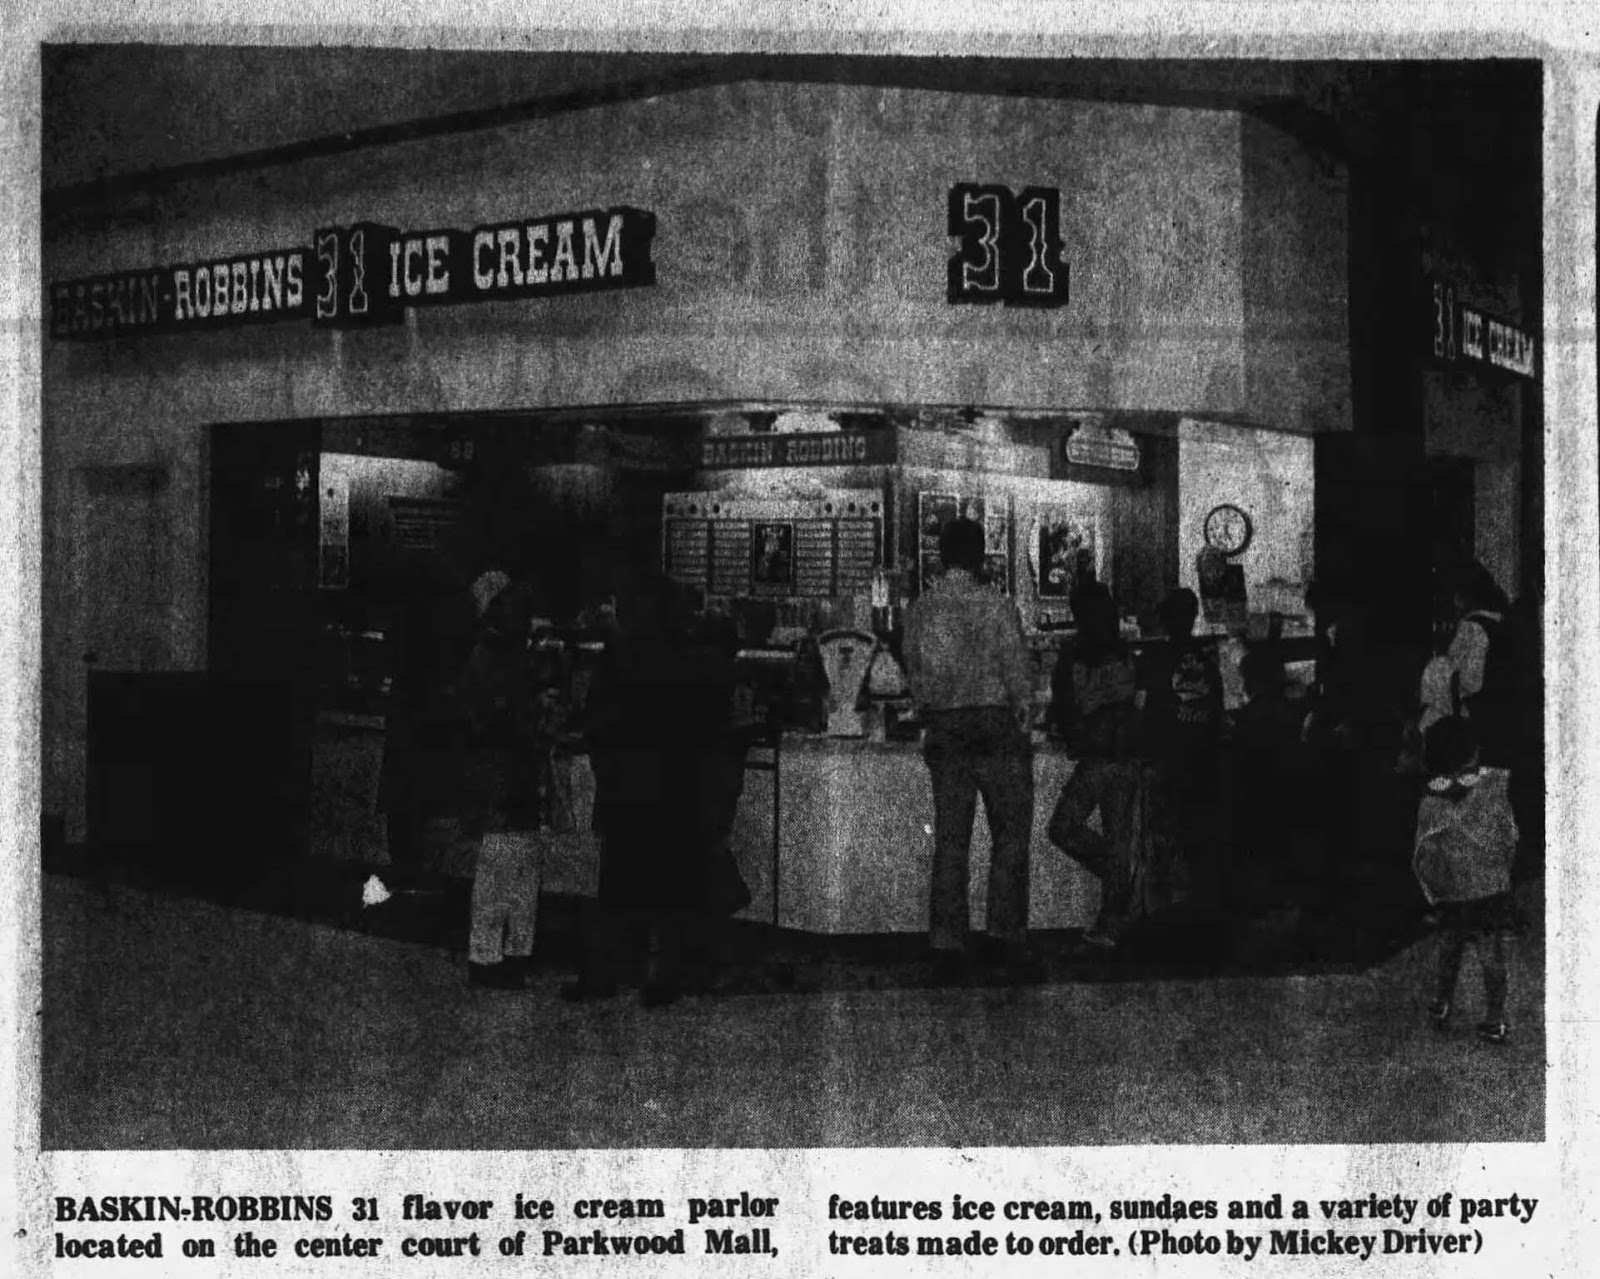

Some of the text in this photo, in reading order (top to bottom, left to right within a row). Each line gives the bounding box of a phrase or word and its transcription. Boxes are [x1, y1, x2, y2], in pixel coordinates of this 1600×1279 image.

[317, 231, 368, 318] 31
[388, 235, 449, 297] ICE
[473, 213, 623, 290] CREAM
[963, 192, 1054, 293] 31
[1462, 308, 1483, 360] ICE
